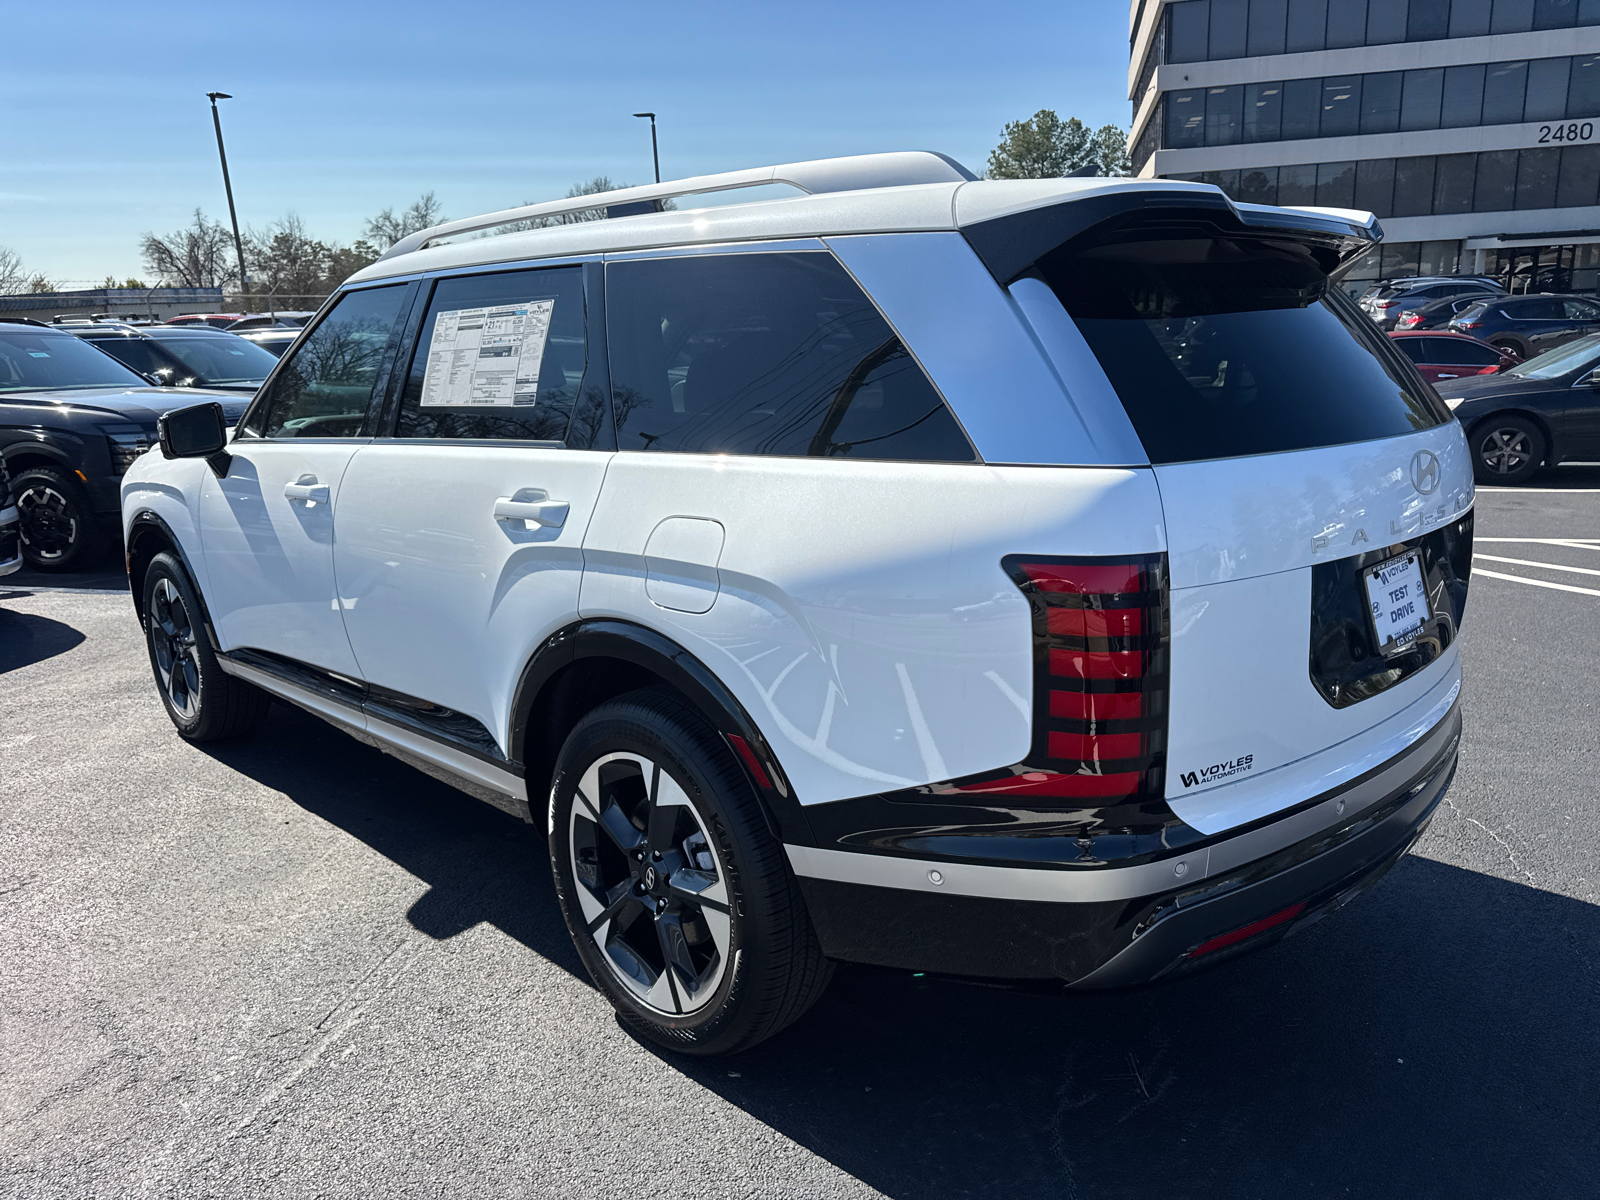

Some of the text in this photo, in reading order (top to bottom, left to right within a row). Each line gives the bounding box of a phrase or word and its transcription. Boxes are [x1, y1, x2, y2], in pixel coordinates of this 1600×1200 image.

[1538, 122, 1594, 144] 2480
[487, 320, 496, 329] 21
[1386, 561, 1409, 578] VOYLES
[1388, 584, 1409, 604] TEST
[1390, 601, 1415, 624] DRIVE
[1396, 637, 1405, 647] ED
[1404, 626, 1425, 642] VOYLES
[662, 748, 702, 796] 255/50 R20
[1199, 753, 1254, 778] VOYLES
[1200, 763, 1253, 785] AUTOMOTIVE
